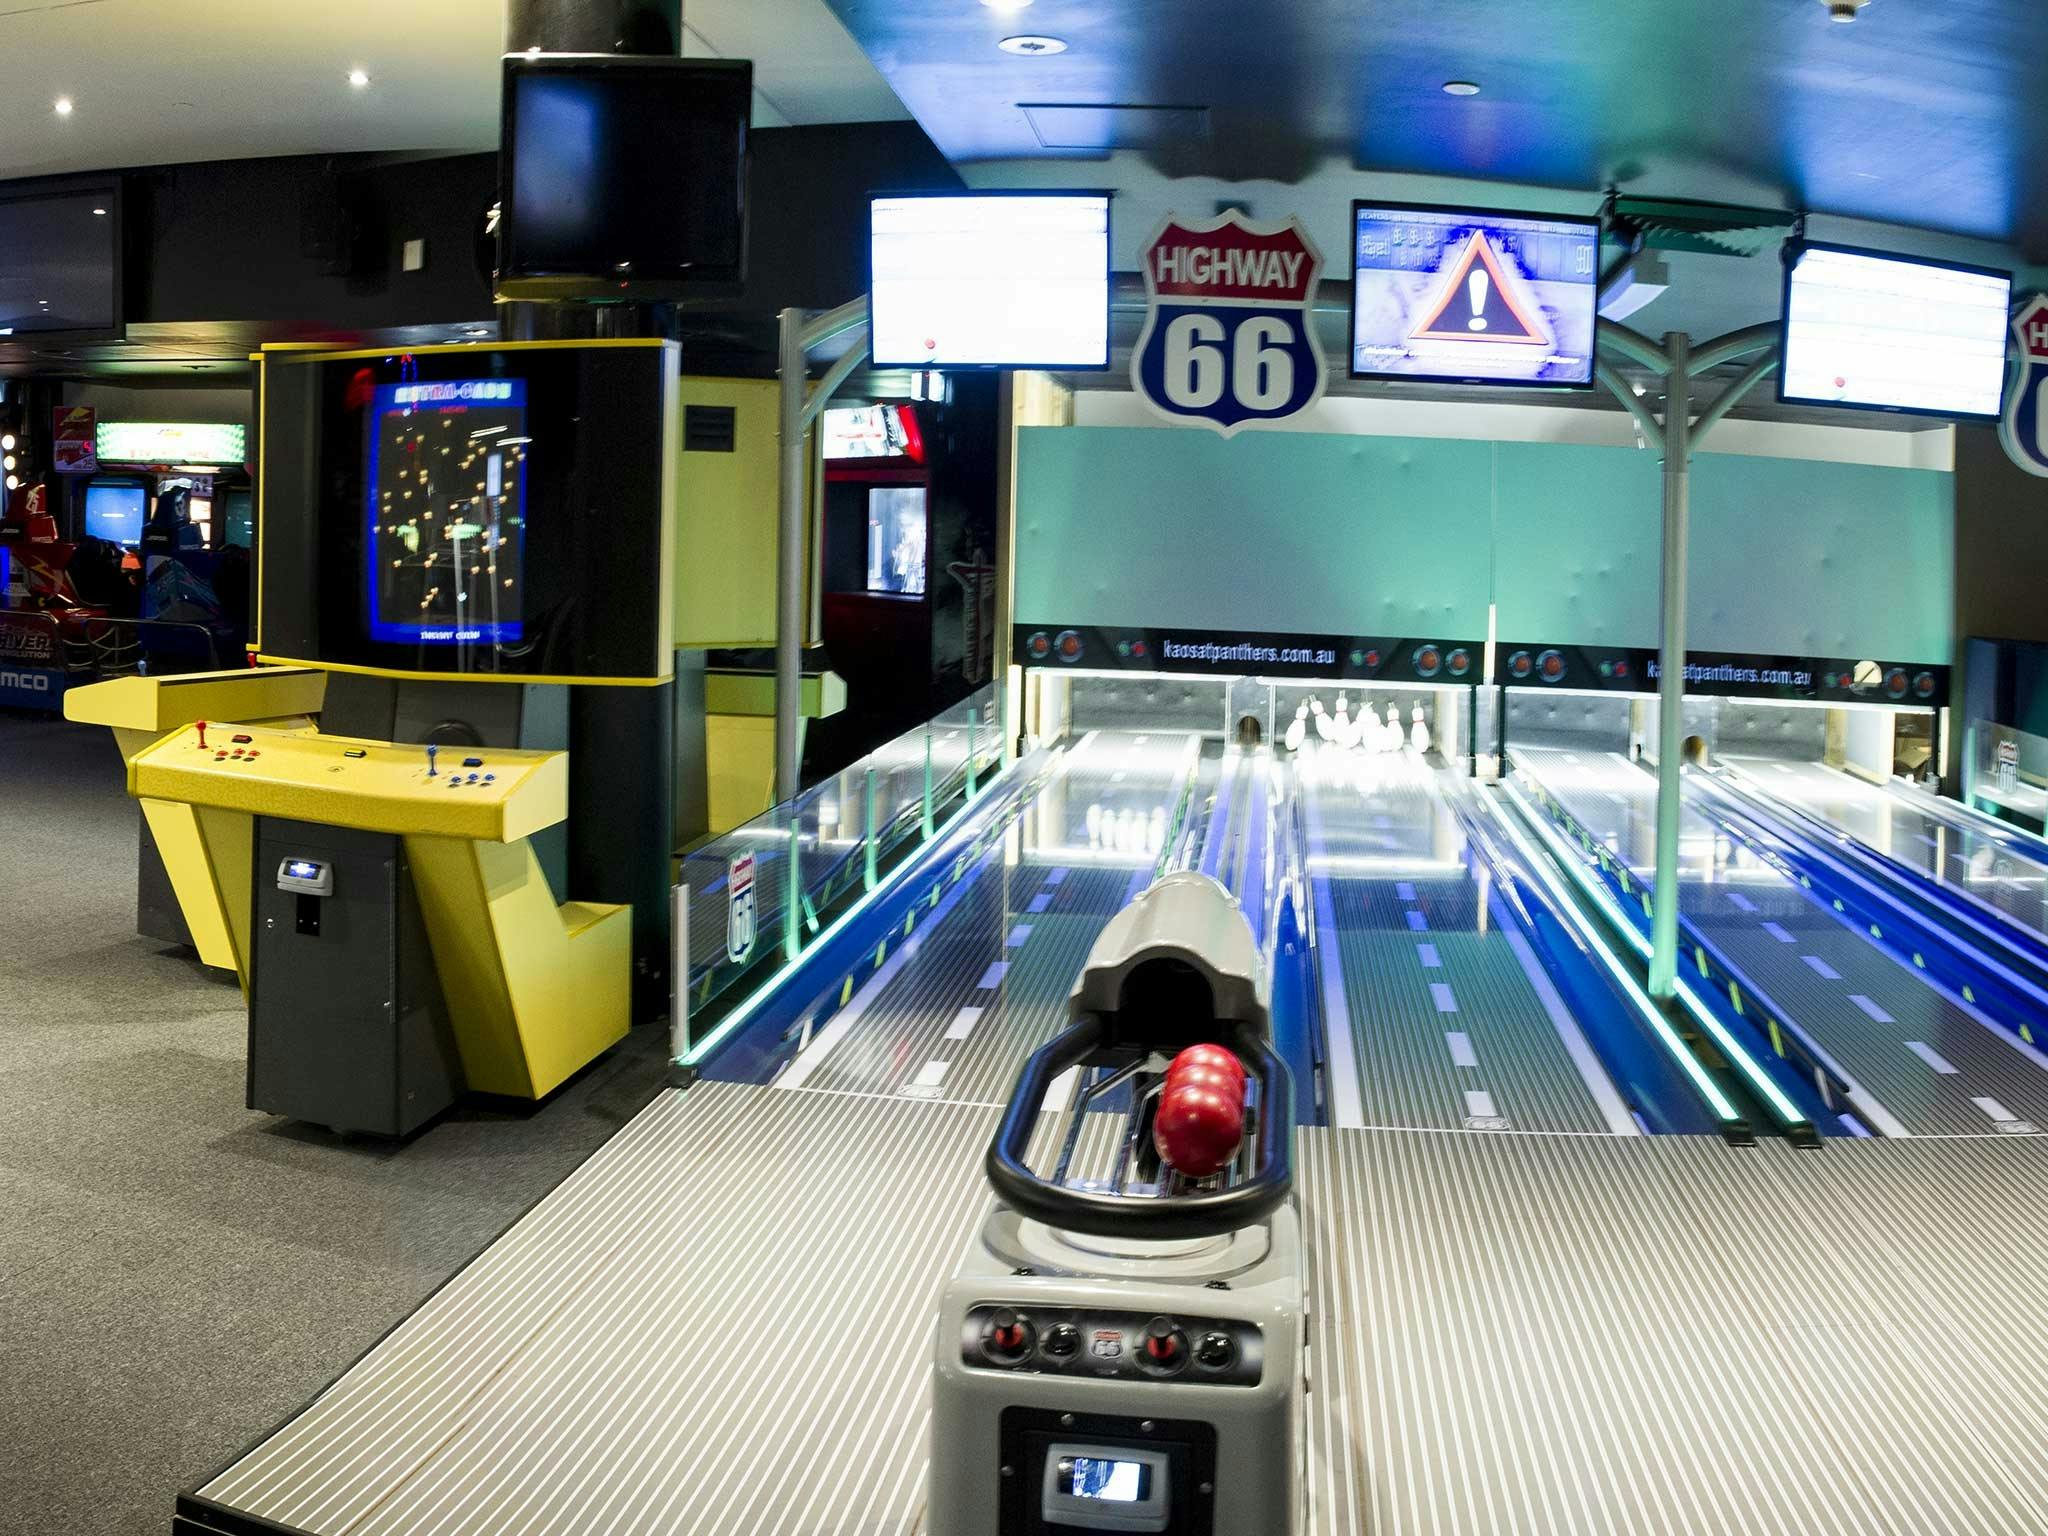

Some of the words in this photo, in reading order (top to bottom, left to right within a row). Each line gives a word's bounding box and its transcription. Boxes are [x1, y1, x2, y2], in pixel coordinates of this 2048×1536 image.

[1156, 245, 1305, 289] HIGHWAY
[1163, 313, 1295, 411] 66
[1163, 640, 1336, 664] kaosatpanthers.com.au
[1647, 660, 1812, 686] kaatpanthers.com.au
